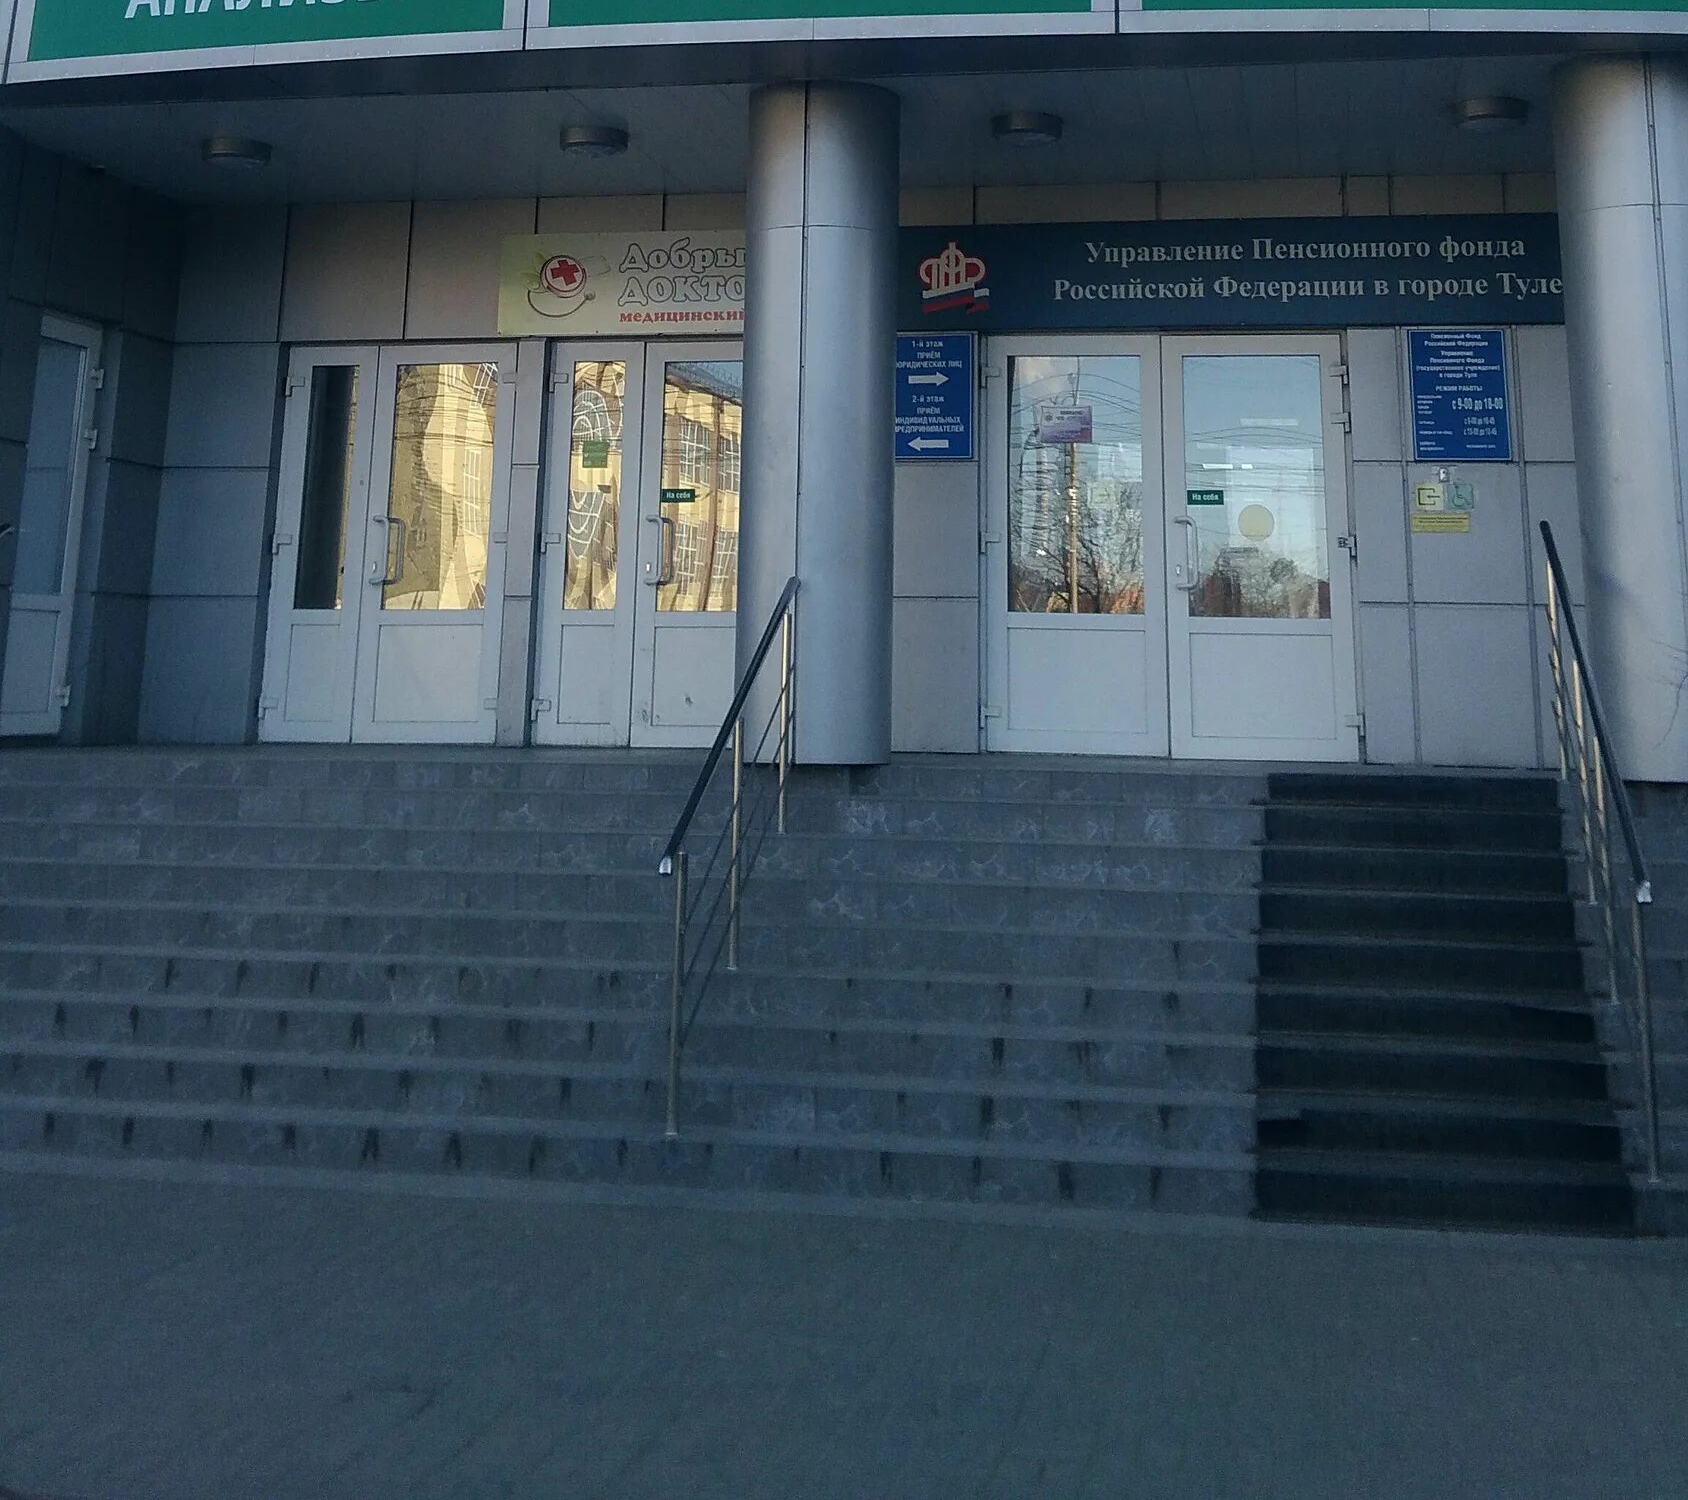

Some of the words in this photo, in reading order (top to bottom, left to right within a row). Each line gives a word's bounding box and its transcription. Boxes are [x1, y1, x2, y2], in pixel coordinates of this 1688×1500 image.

[617, 237, 746, 274] Добры
[1085, 242, 1244, 268] Управление
[1251, 238, 1431, 260] Пенсионного
[1439, 235, 1526, 263] фонда
[617, 276, 746, 307] ДОКТО
[1053, 277, 1206, 301] Российской
[1213, 277, 1365, 303] Федерации
[1374, 283, 1390, 296] в
[1399, 277, 1489, 301] городе
[1496, 272, 1564, 300] Туле
[1192, 493, 1202, 501] На
